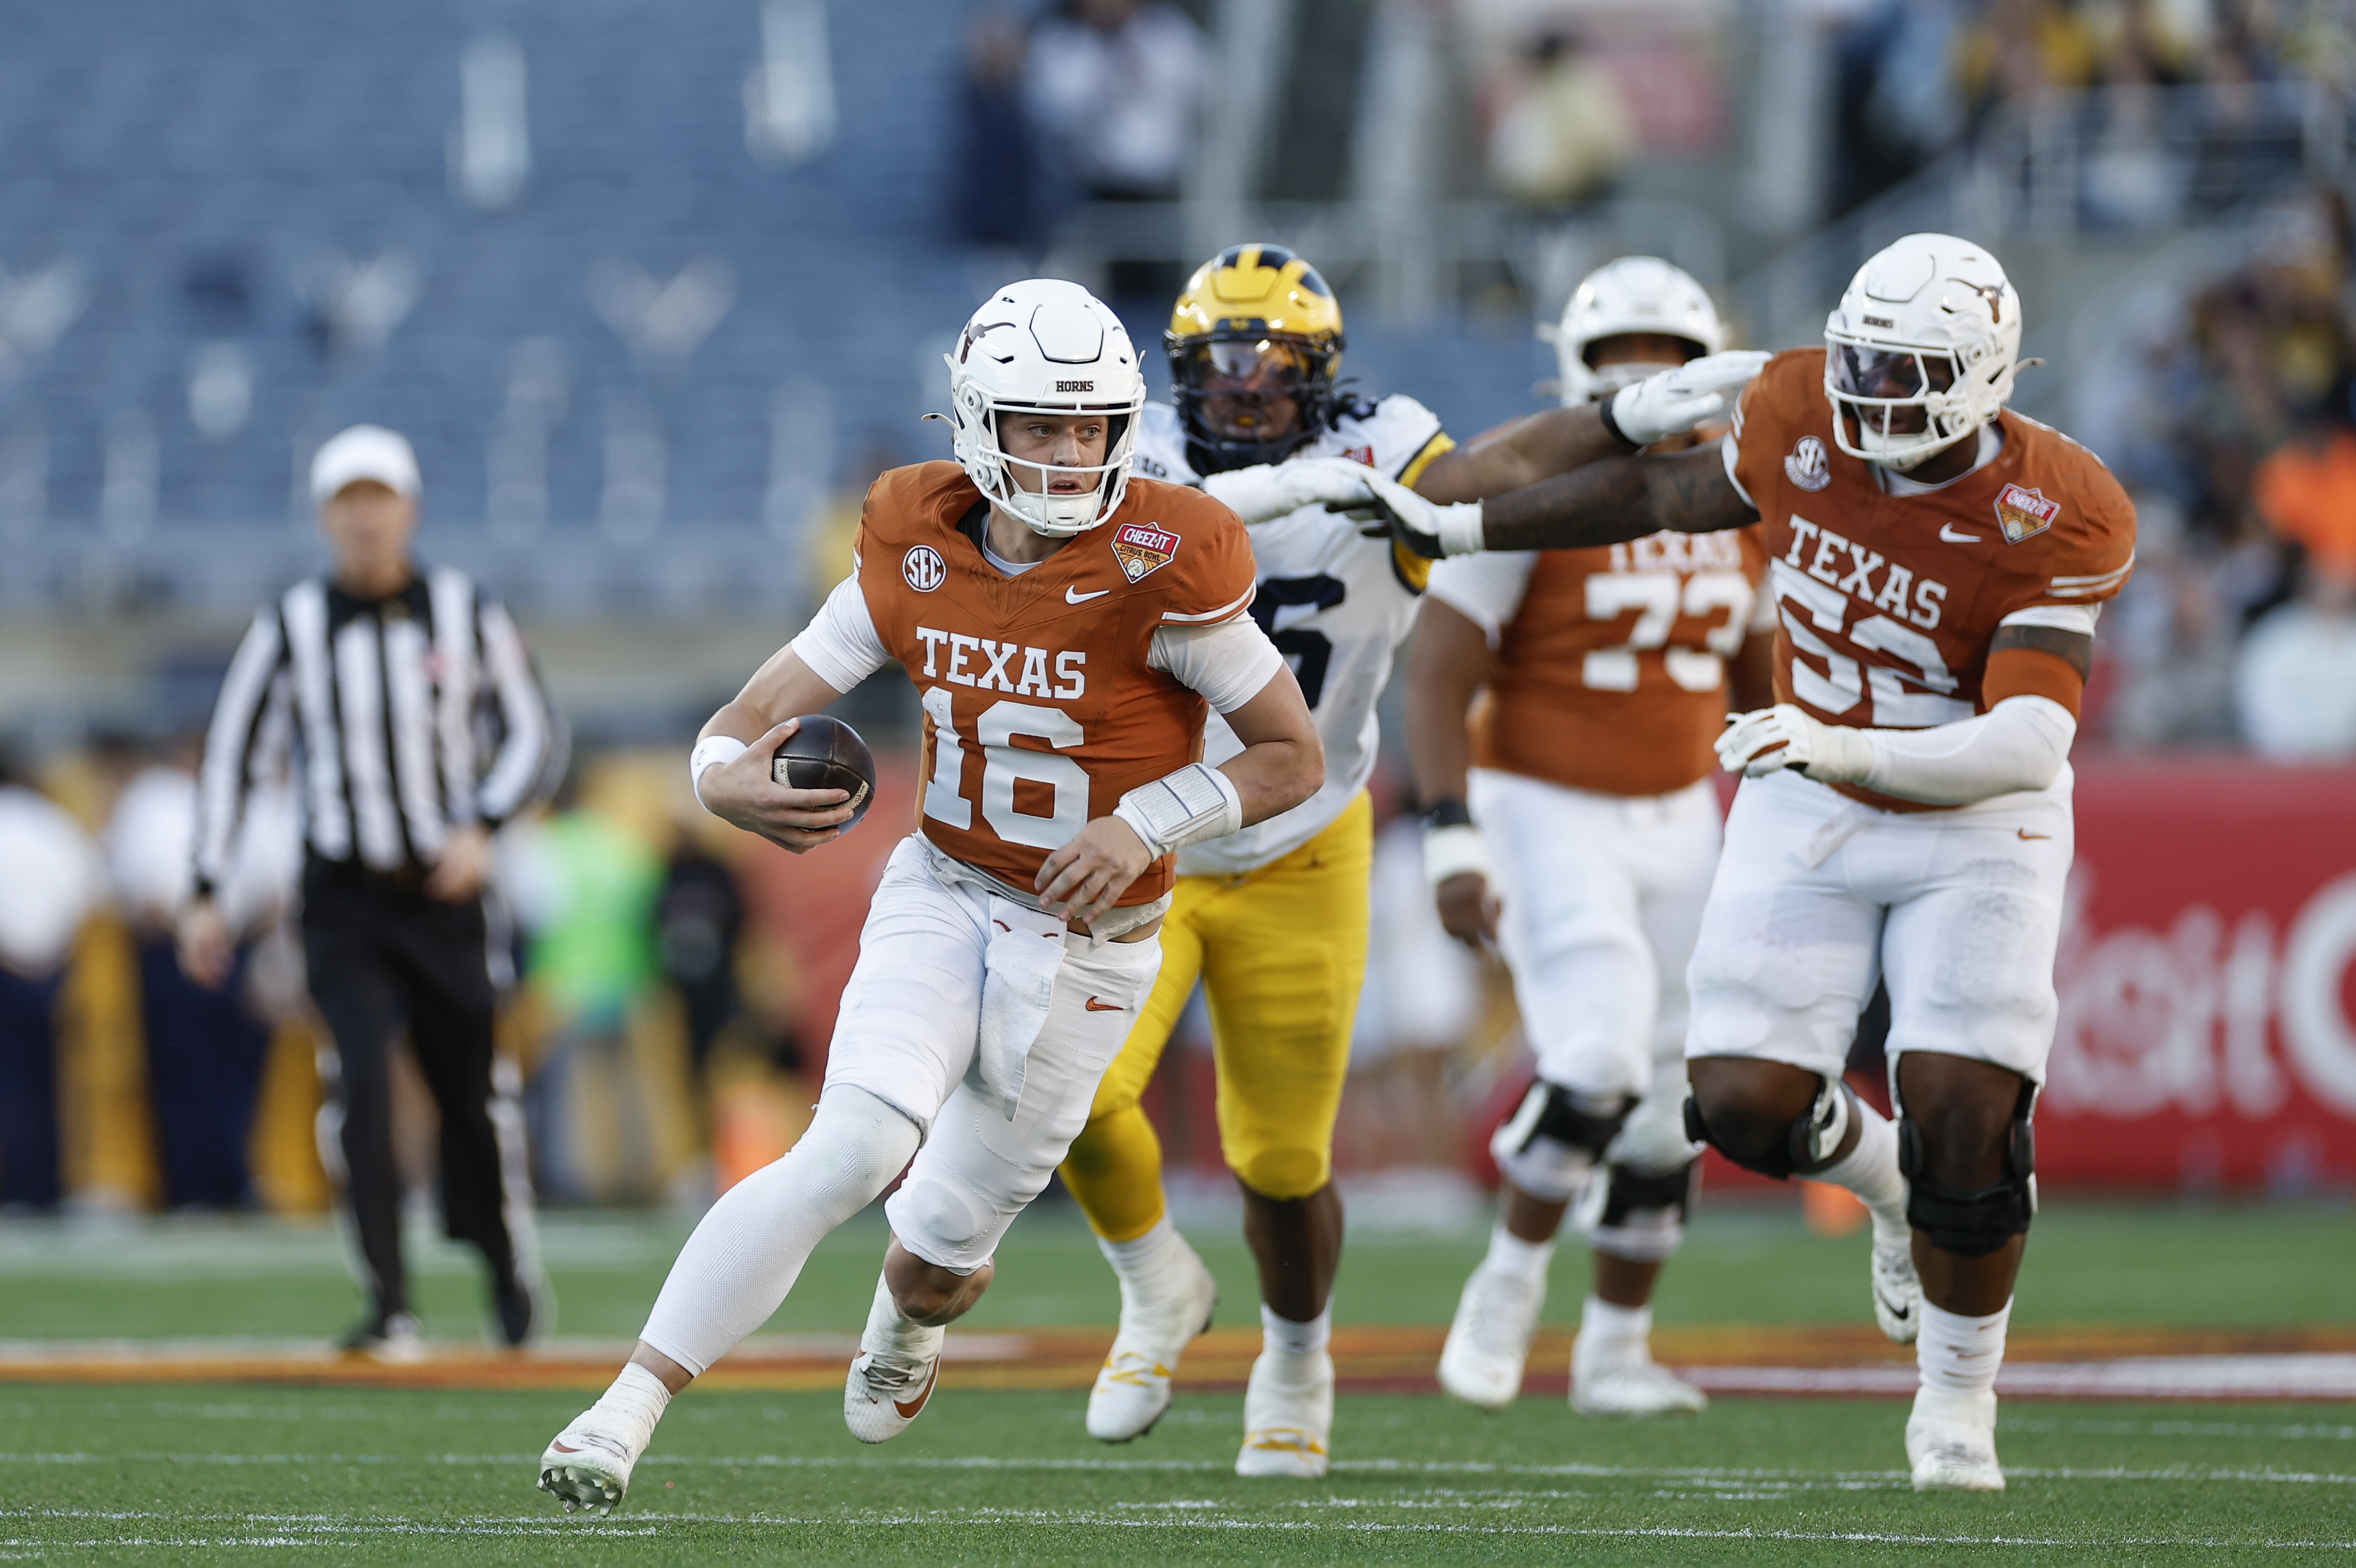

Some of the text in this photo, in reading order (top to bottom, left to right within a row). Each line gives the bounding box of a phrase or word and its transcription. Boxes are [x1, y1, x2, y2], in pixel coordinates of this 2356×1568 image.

[1056, 381, 1094, 392] HORNS
[1796, 439, 1825, 475] SEC
[907, 549, 942, 588] SEC
[1120, 545, 1160, 561] CITRUS BOWL
[1785, 513, 1947, 630] TEXAS
[916, 626, 1086, 699] TEXAS
[1583, 570, 1756, 693] 73
[1771, 556, 1975, 726] 52
[922, 686, 1090, 851] 16
